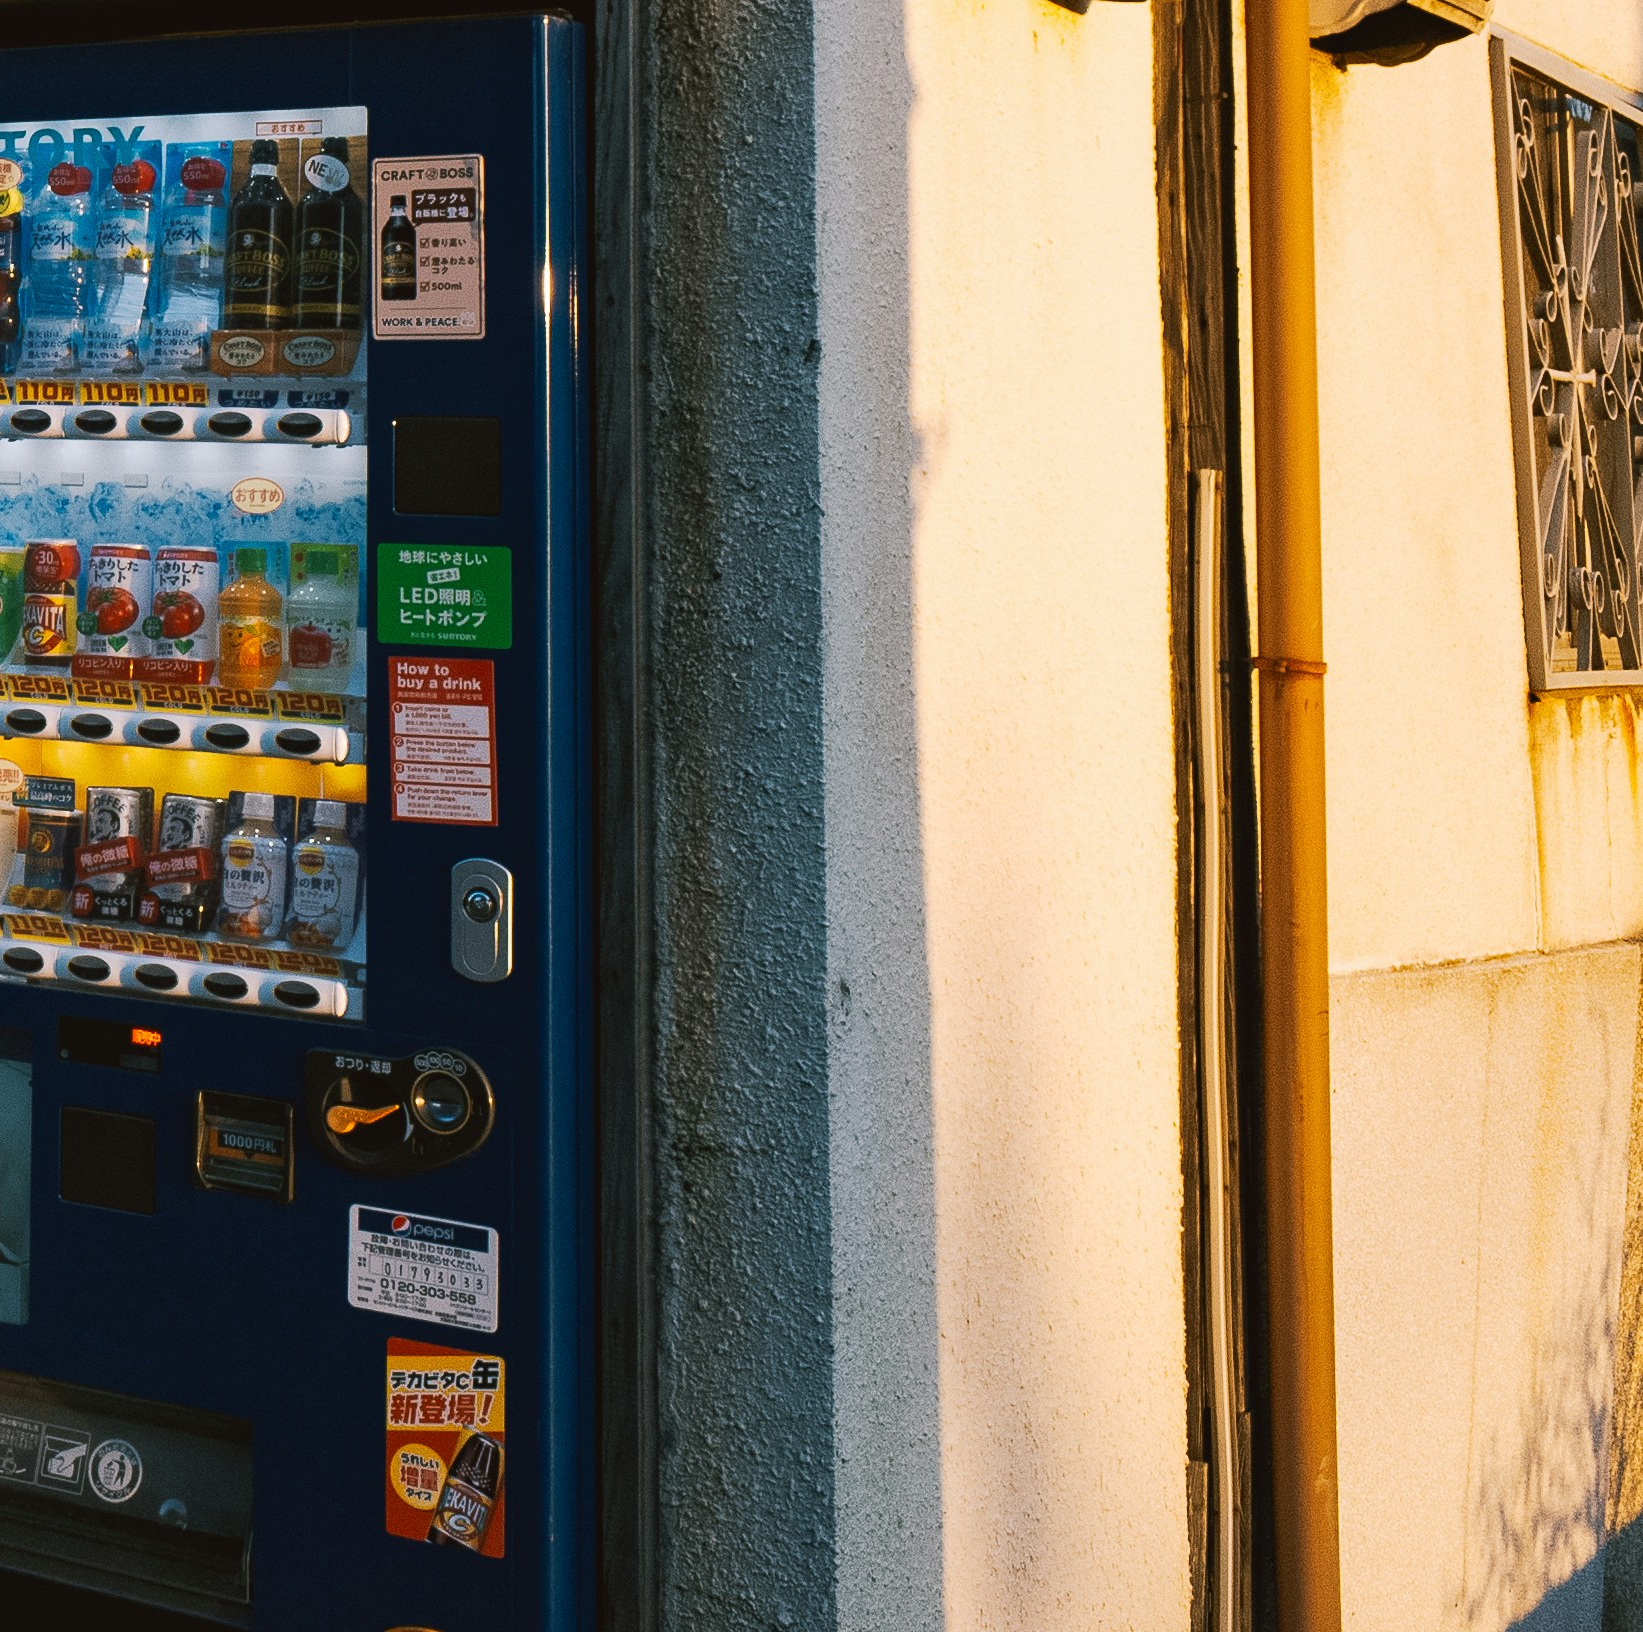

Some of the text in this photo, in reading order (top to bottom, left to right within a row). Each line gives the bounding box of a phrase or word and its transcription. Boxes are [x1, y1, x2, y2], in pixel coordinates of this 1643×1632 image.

[381, 167, 473, 181] CRAFT BOSS
[414, 192, 466, 205] ブラックも
[431, 237, 467, 247] 香り高い
[432, 266, 448, 275] コク
[431, 281, 462, 291] 500ml
[381, 318, 413, 327] WORK
[415, 317, 422, 327] &
[16, 382, 75, 399] 110円
[81, 383, 139, 400] 110円
[145, 384, 206, 401] 110円
[235, 488, 282, 505] おすすめ
[398, 550, 488, 566] 地球にやさしい
[94, 570, 127, 583] トマト
[159, 575, 191, 586] トマト
[400, 608, 488, 628] ヒートポンプ
[437, 632, 477, 641] SUNTORY
[396, 662, 450, 676] How to
[9, 678, 68, 694] 120円
[74, 683, 133, 699] 120円
[396, 675, 482, 691] buy a drink
[141, 686, 200, 703] 120円
[207, 689, 268, 708] 120円
[278, 693, 339, 712] 120円
[80, 845, 130, 867] 俺の微糖
[149, 855, 198, 874] 俺の微糖
[74, 892, 89, 910] 新
[139, 900, 155, 917] 新
[6, 915, 63, 934] 110円
[77, 927, 133, 946] 120円
[140, 934, 199, 955] 120円
[210, 943, 269, 963] 120円
[335, 1055, 391, 1074] おつり・返却
[223, 1133, 277, 1154] 1000円札
[413, 1223, 455, 1240] pepsi
[380, 1278, 477, 1305] 0120-303-558
[390, 1359, 500, 1390] デカビタC缶
[389, 1393, 493, 1425] 新登場!
[400, 1452, 440, 1469] うれしい
[400, 1464, 439, 1492] 増量
[405, 1488, 432, 1501] タイプ
